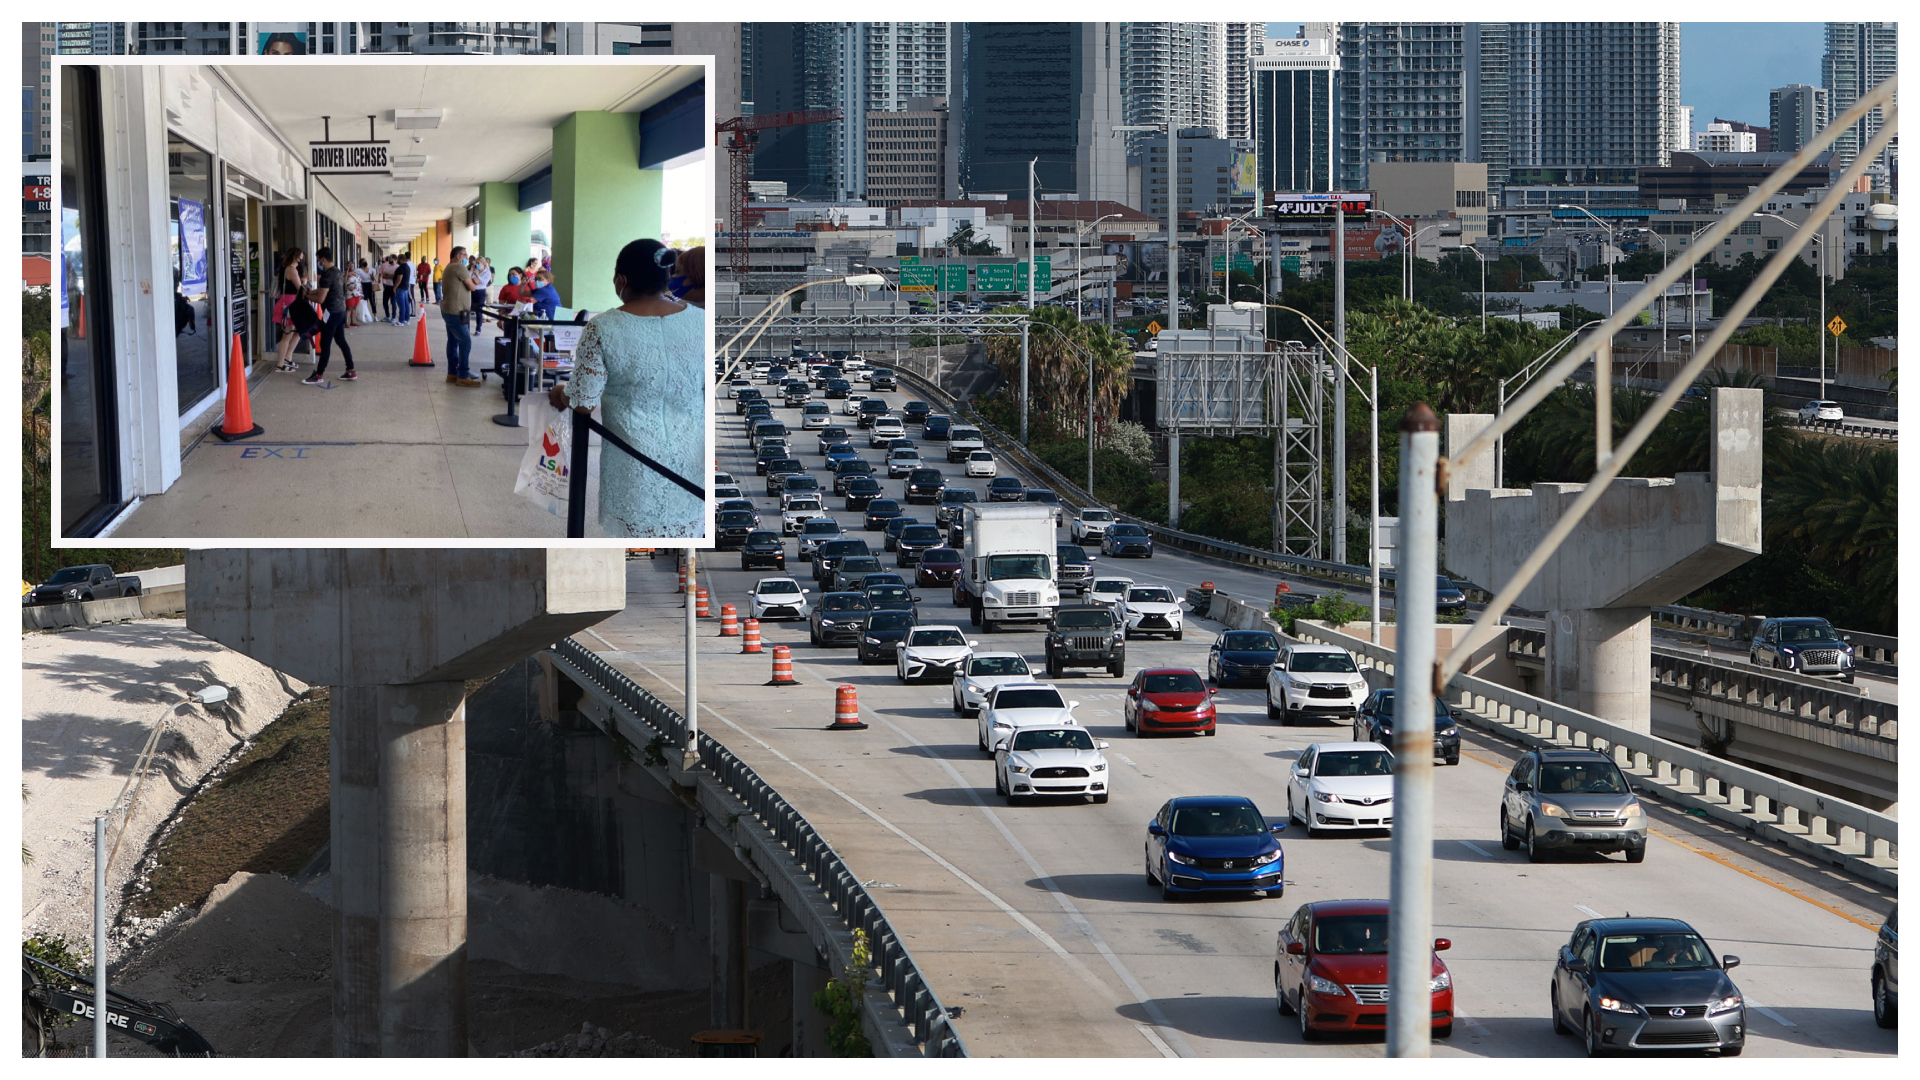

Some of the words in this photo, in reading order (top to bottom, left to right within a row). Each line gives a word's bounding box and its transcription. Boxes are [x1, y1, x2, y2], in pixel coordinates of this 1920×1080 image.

[312, 148, 344, 168] DRIVER
[346, 147, 387, 167] LICENSES
[1291, 202, 1329, 214] JULY
[1331, 202, 1366, 213] SALE
[240, 447, 311, 459] EXI
[72, 1000, 130, 1028] DERE
